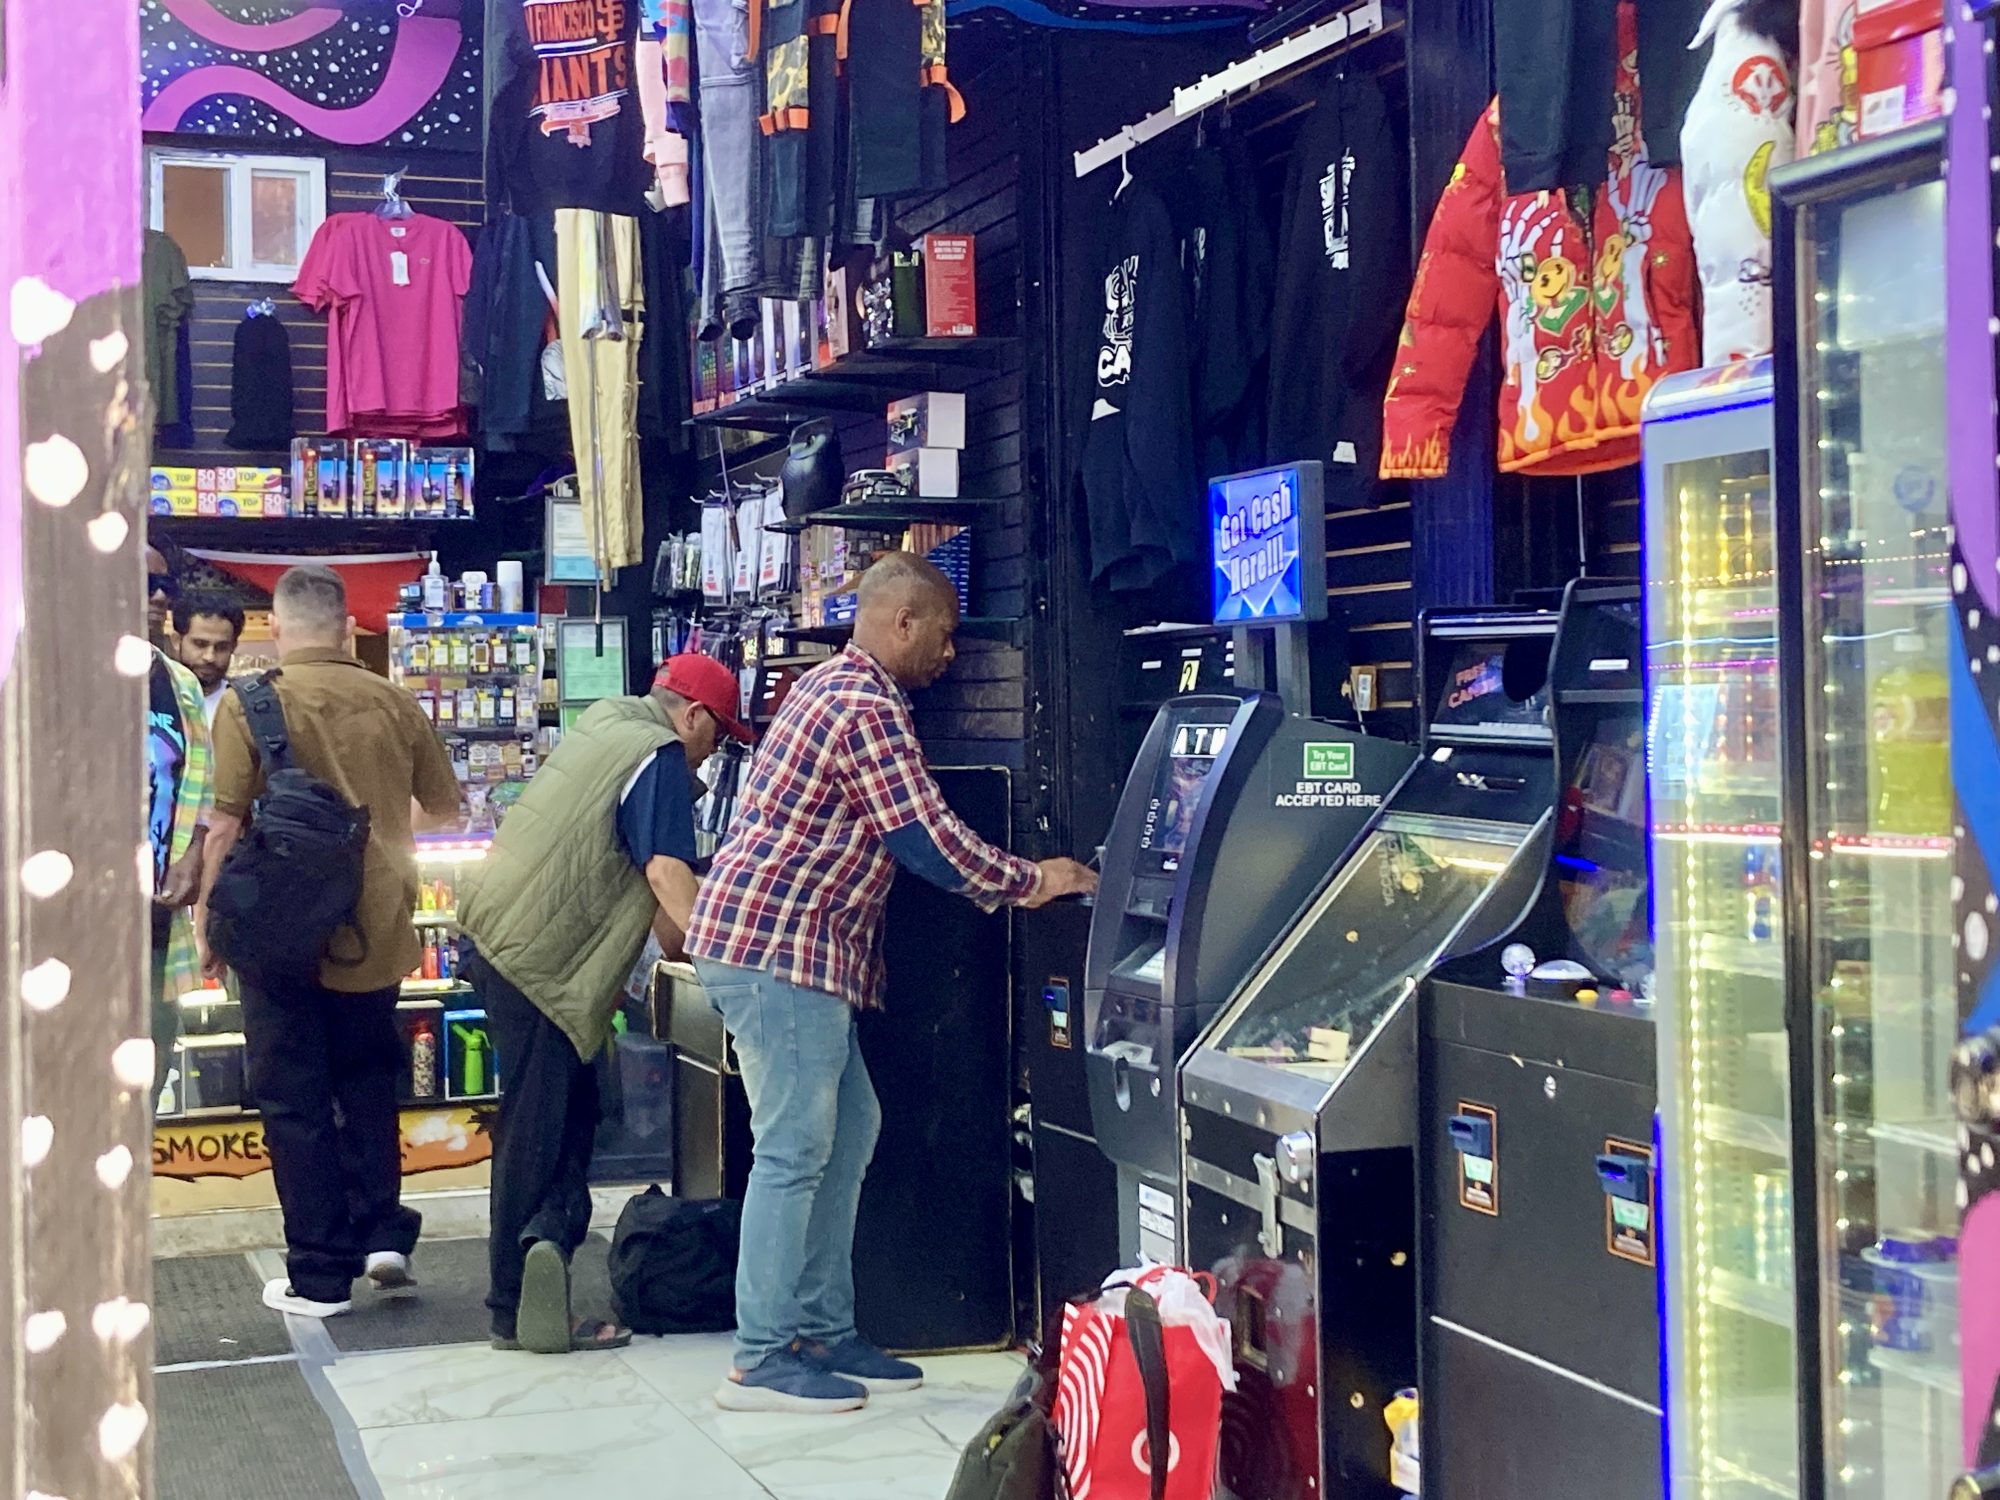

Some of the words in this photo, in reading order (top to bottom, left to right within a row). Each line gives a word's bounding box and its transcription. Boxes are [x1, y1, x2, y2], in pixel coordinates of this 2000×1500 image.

[535, 2, 595, 42] FRANCISCO
[532, 45, 626, 106] IANTS
[175, 474, 192, 482] TOP
[198, 469, 216, 480] 50
[217, 468, 236, 480] 50
[238, 472, 258, 481] TOP
[176, 496, 192, 505] TOP
[198, 492, 216, 504] 50
[243, 498, 258, 506] TOP
[264, 494, 282, 505] 50
[1221, 506, 1247, 553] Get
[1252, 481, 1291, 535] Cash
[1231, 532, 1283, 596] Here!!!
[1173, 727, 1227, 755] ATM
[1311, 749, 1325, 761] Try
[1326, 750, 1345, 760] Your
[1310, 762, 1326, 771] EBT
[1328, 761, 1348, 771] Card
[1296, 782, 1323, 794] EBT
[1324, 782, 1361, 794] CARD
[1275, 794, 1345, 807] ACCEPTED
[1346, 794, 1382, 807] HERE
